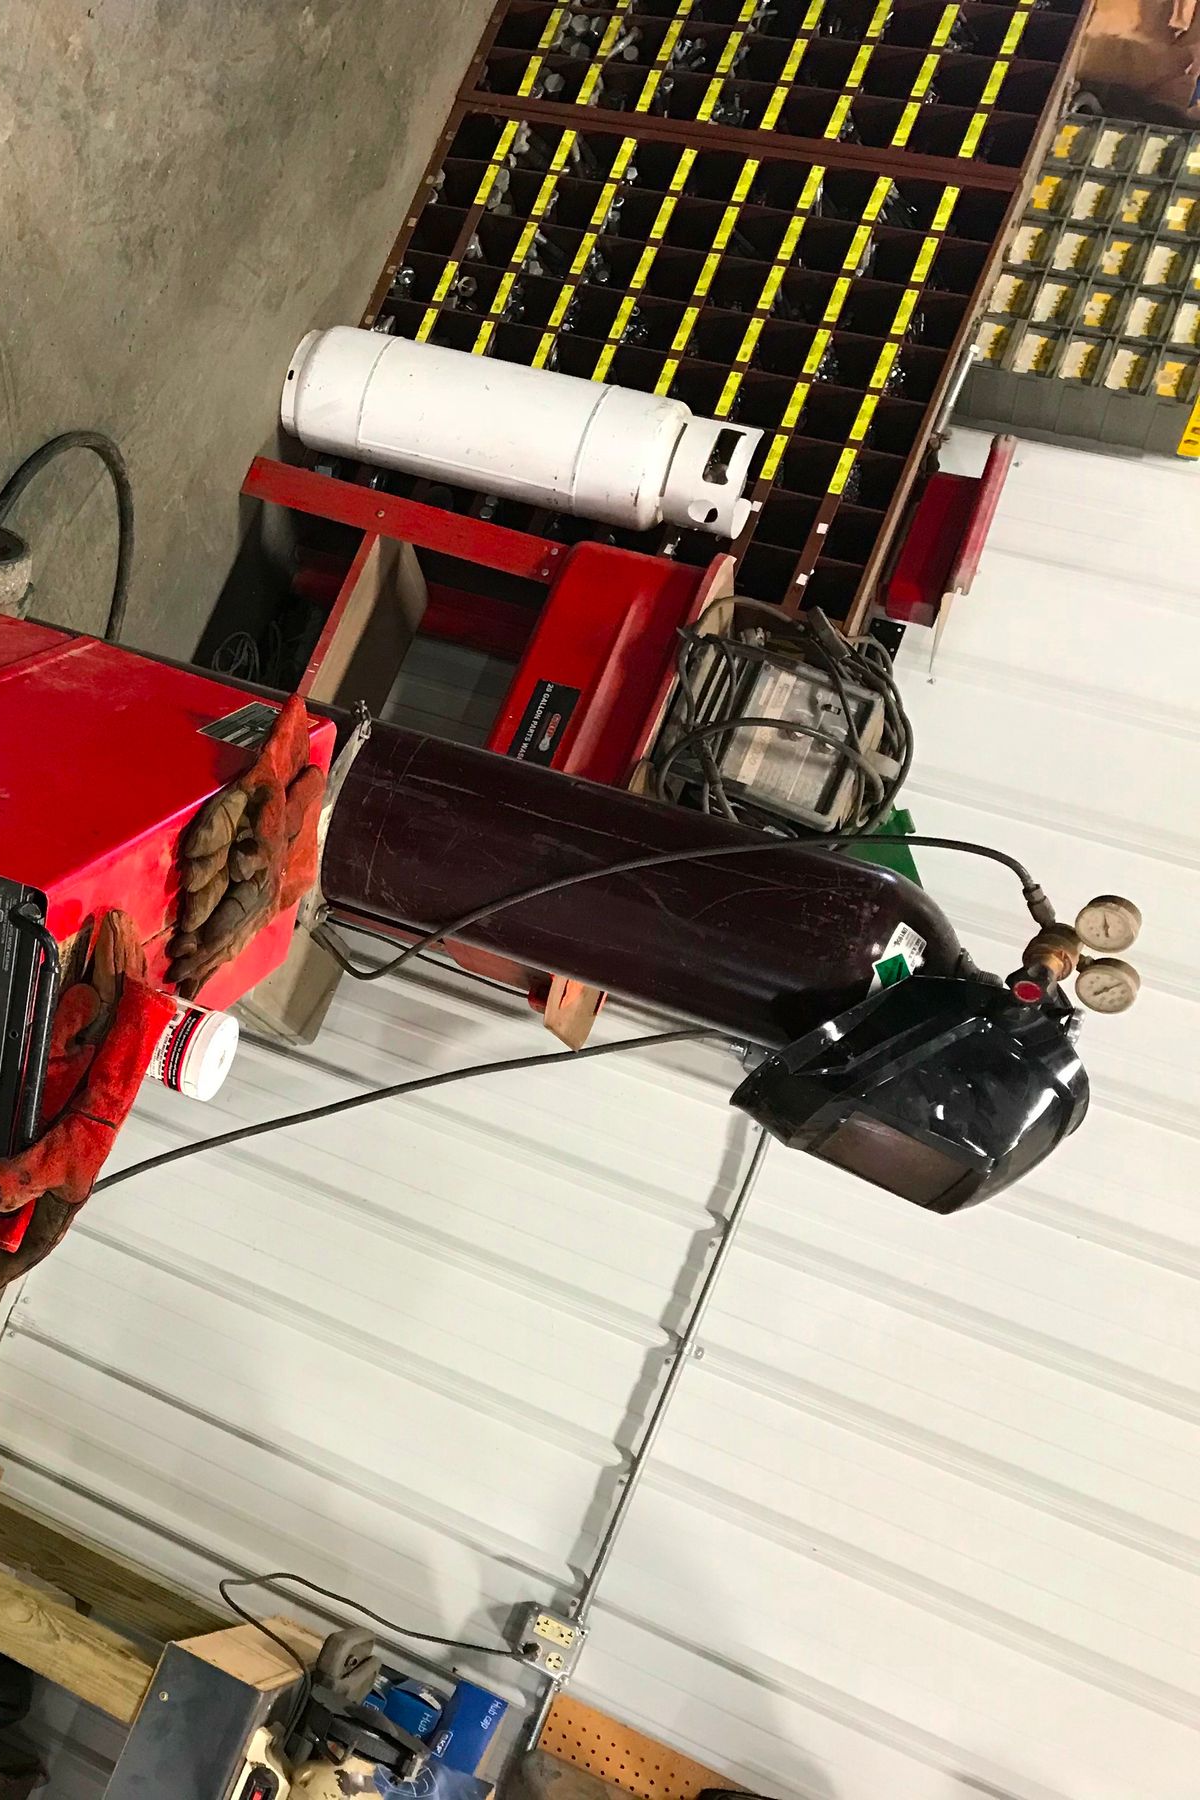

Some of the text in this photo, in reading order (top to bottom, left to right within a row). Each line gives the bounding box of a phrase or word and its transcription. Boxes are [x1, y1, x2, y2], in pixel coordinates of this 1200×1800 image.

[533, 693, 550, 720] GALLON
[524, 720, 538, 742] PARTS
[417, 1712, 433, 1731] Hub
[480, 1700, 503, 1730] Hub cap
